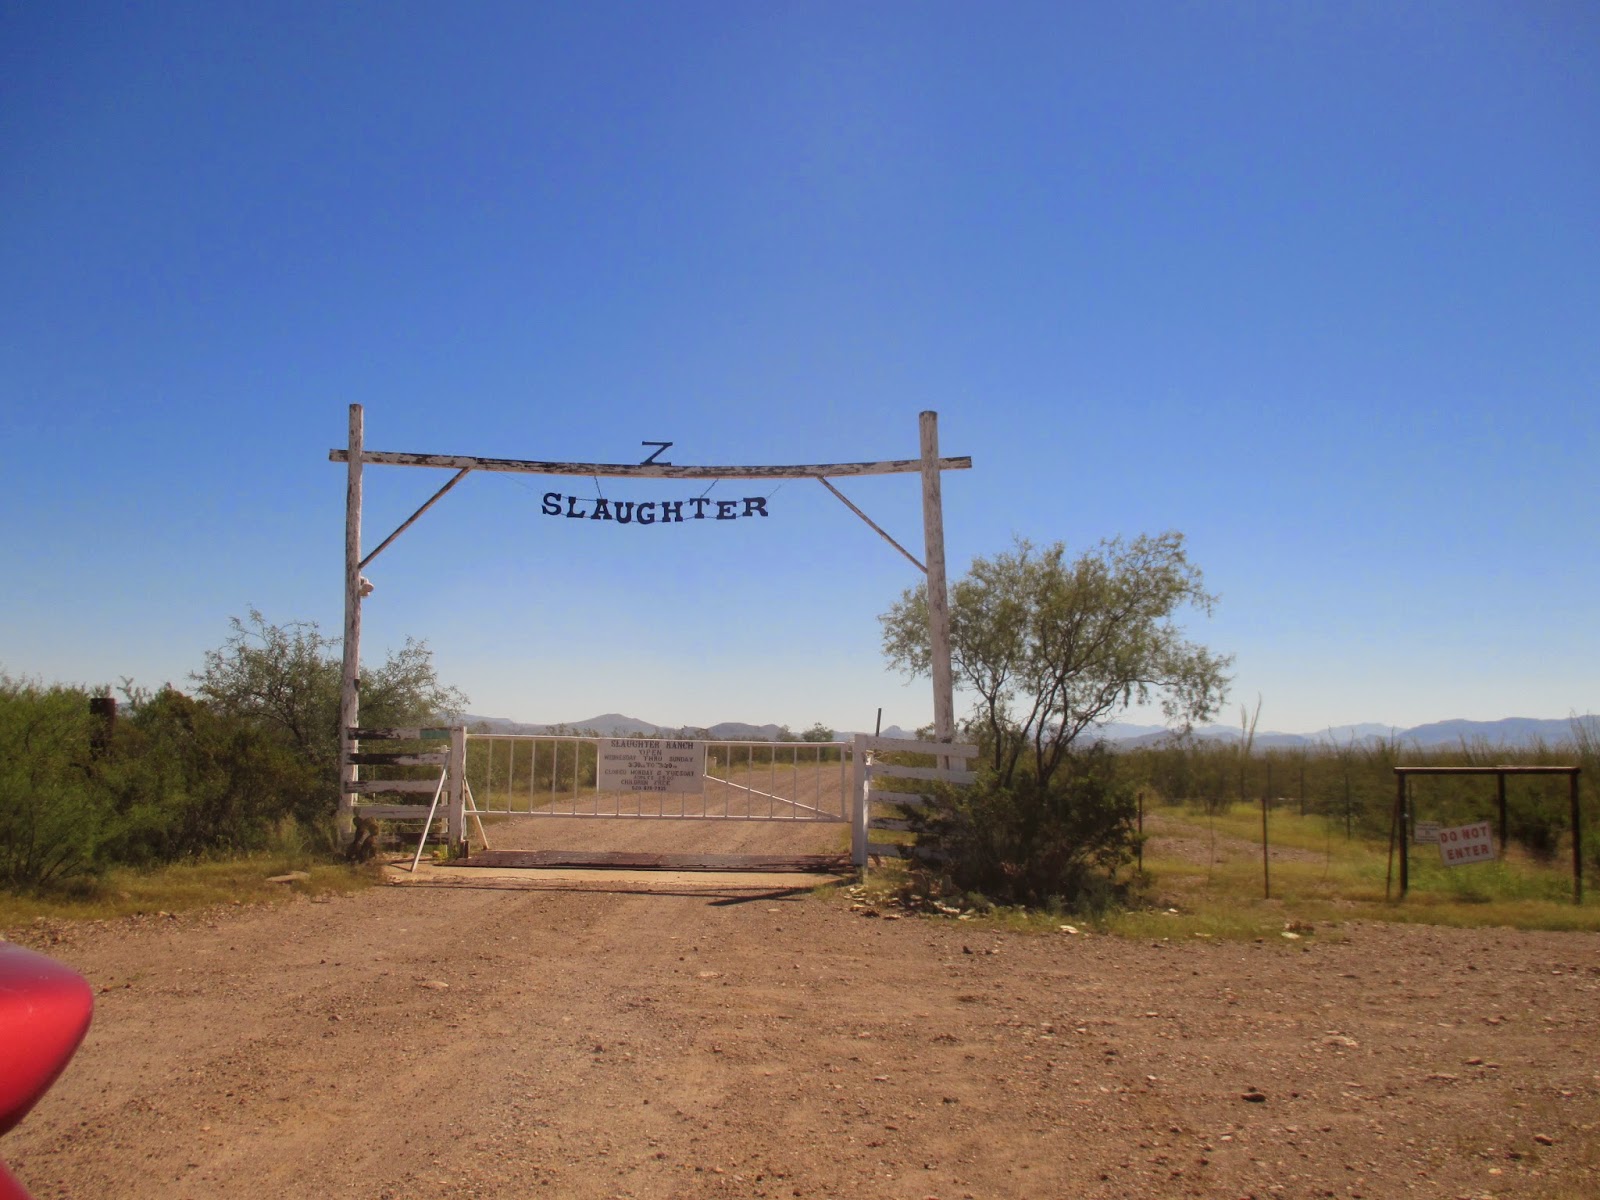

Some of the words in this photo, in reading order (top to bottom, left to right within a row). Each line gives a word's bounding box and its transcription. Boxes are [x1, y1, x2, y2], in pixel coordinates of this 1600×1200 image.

[640, 441, 673, 466] Z
[541, 492, 769, 524] SLAUGHTER
[611, 740, 660, 749] SLAUGHTER
[666, 741, 694, 749] RANCH
[1440, 830, 1458, 843] DO
[1461, 826, 1487, 840] NOT
[1447, 844, 1489, 860] ENTER
